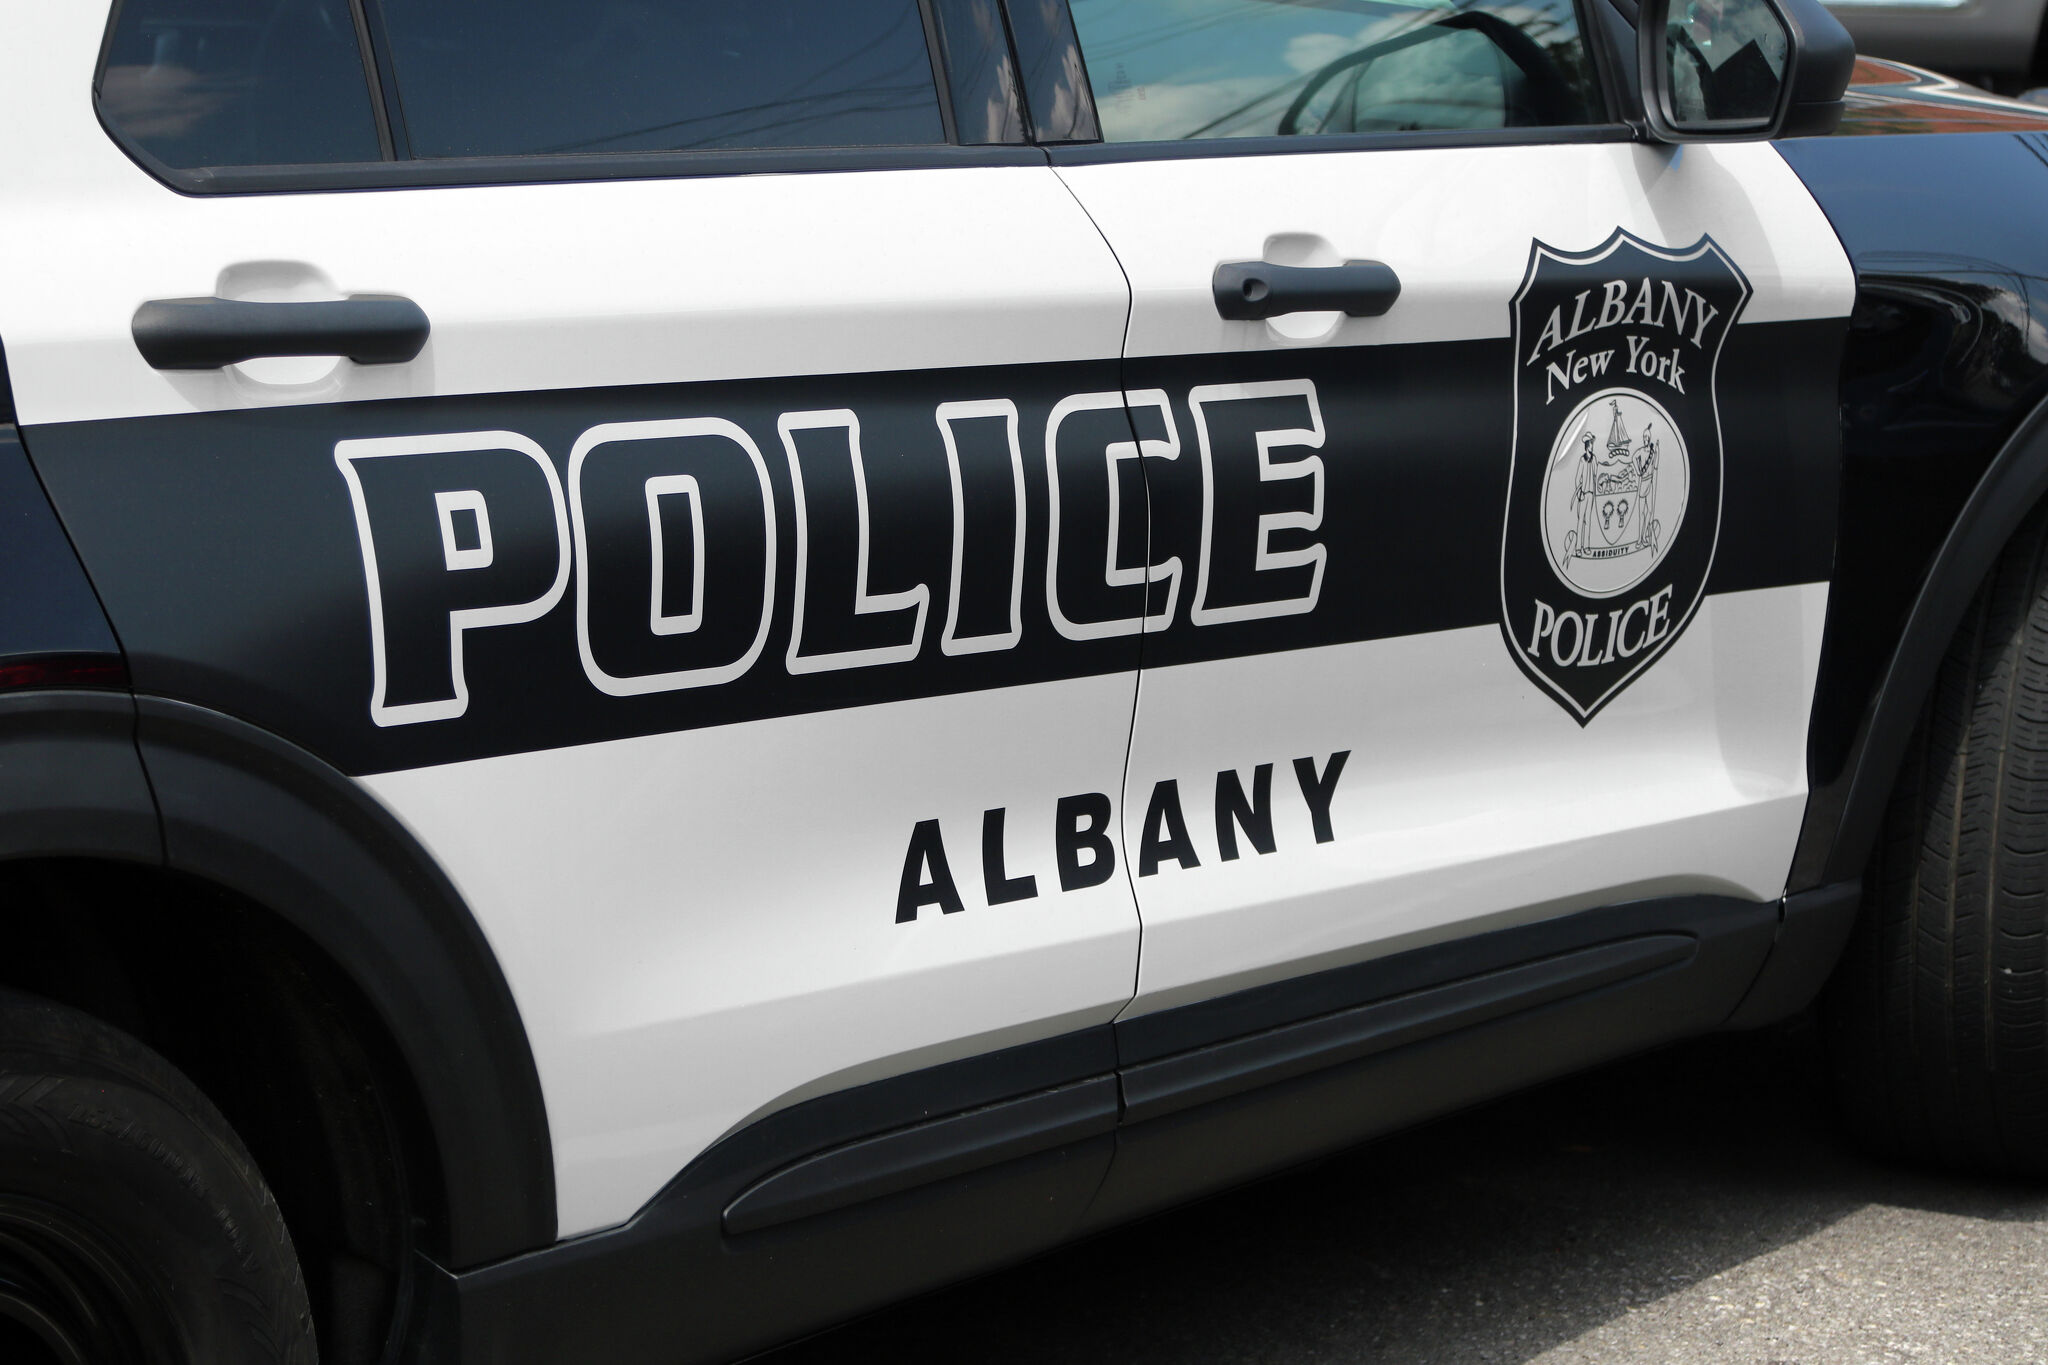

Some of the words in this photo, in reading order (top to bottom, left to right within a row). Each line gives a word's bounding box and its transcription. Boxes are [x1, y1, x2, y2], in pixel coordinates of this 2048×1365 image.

[1526, 276, 1719, 366] ALBANY
[1545, 349, 1615, 406] New
[1625, 335, 1688, 395] York
[334, 378, 1328, 728] POLICE
[1593, 547, 1629, 558] ASSIDUITY
[1527, 583, 1674, 667] POLICE
[896, 749, 1352, 925] ALBANY
